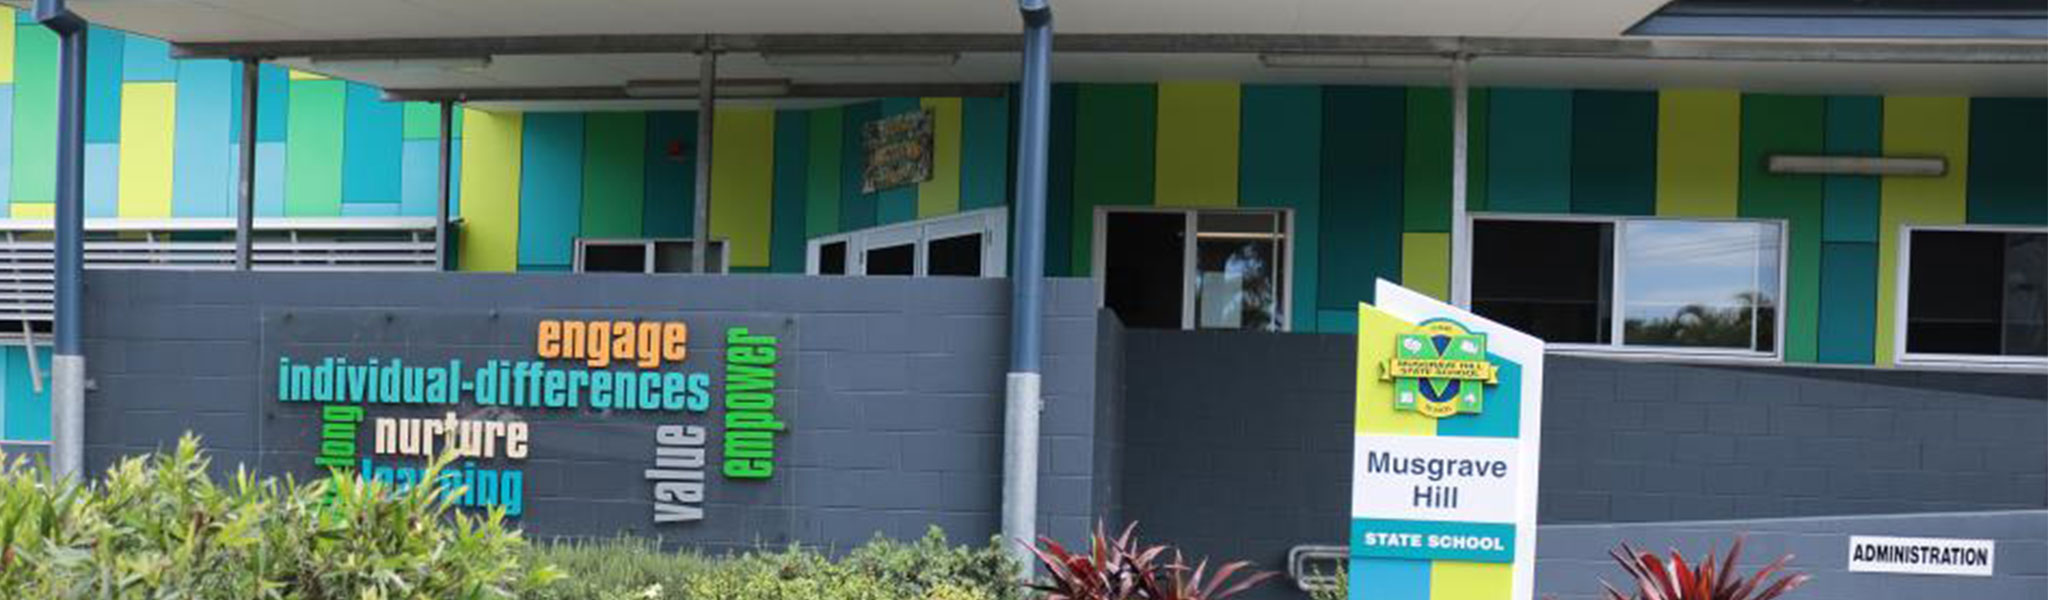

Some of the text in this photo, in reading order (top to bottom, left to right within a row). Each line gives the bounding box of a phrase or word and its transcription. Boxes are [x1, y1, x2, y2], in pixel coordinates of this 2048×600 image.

[538, 320, 687, 367] engage
[278, 358, 710, 411] individual-differences
[723, 327, 777, 478] empower
[375, 412, 528, 458] nurture
[645, 425, 705, 522] value
[1367, 451, 1507, 482] Musgrave
[1412, 486, 1457, 509] Hill
[1364, 532, 1505, 551] STATE SCHOOL
[1853, 544, 1989, 566] ADMINISTRATION
